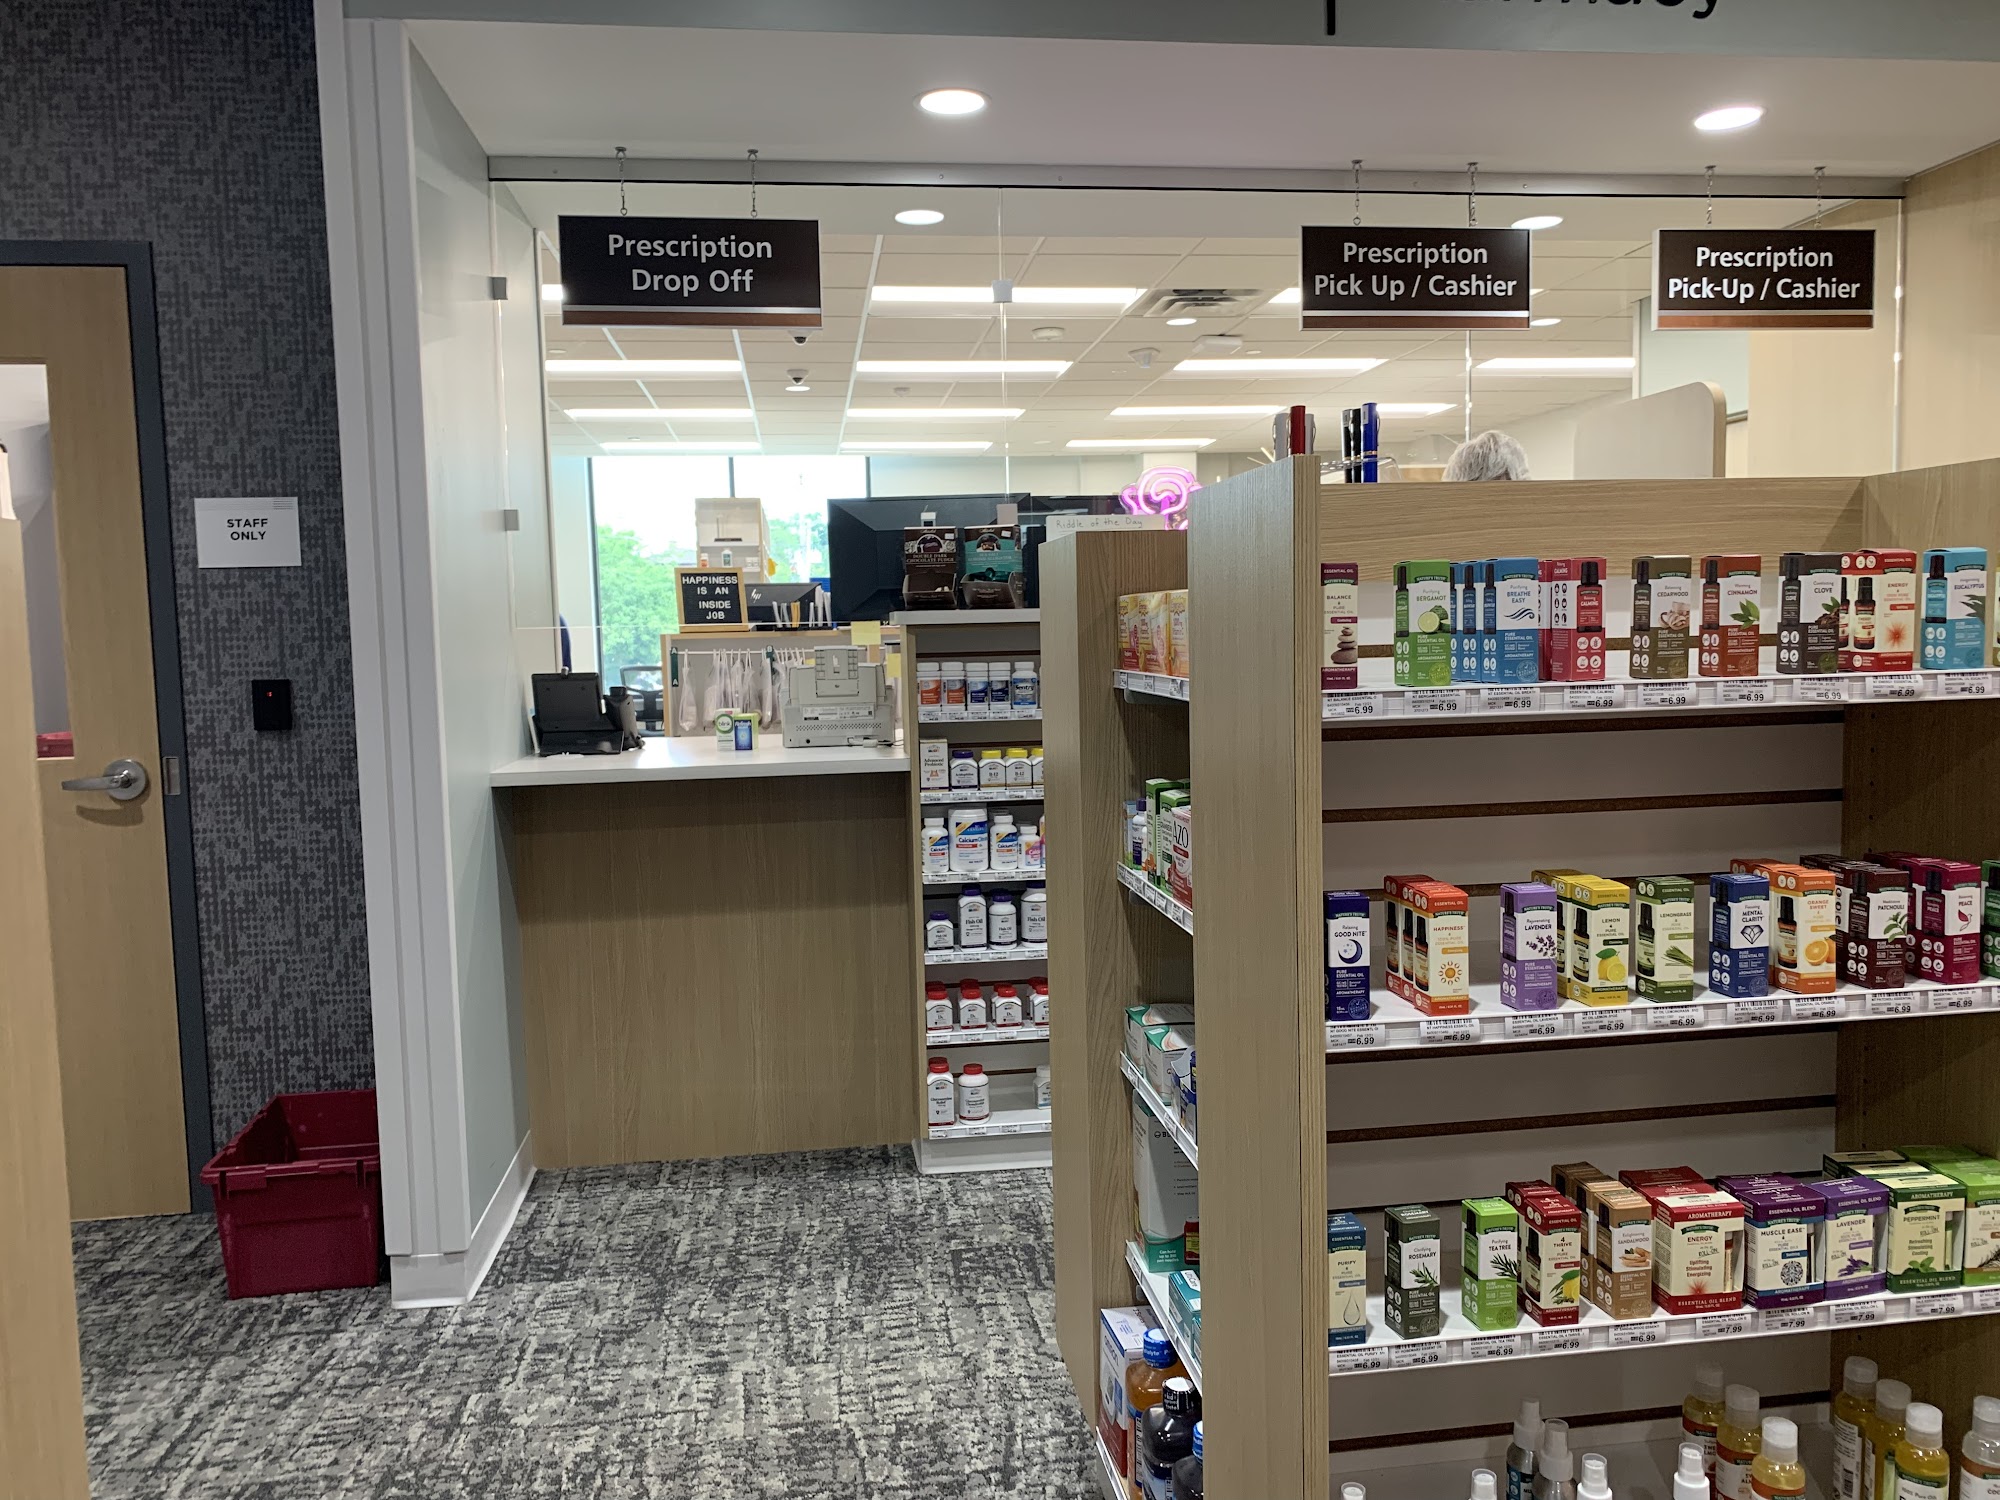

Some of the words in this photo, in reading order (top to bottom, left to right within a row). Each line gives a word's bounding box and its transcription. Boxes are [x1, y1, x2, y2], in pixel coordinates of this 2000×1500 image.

[608, 234, 773, 262] Prescription
[1343, 242, 1488, 268] Prescription
[1695, 246, 1834, 272] Prescription
[632, 269, 699, 296] Drop
[709, 269, 754, 292] Off
[1314, 274, 1363, 296] Pick
[1371, 275, 1404, 301] Up
[1411, 274, 1420, 297] /
[1428, 274, 1516, 297] Cashier
[1668, 278, 1754, 305] Pick-Up
[1759, 278, 1769, 301] /
[1776, 278, 1860, 300] Cashier
[227, 518, 268, 528] STAFF
[1056, 520, 1082, 528] Riddle
[1126, 518, 1142, 528] Day
[230, 531, 266, 540] ONLY
[683, 576, 737, 585] HAPPINESS
[699, 601, 731, 609] INSIDE
[706, 611, 725, 619] JOB
[1354, 706, 1373, 714] 6.99
[1438, 703, 1456, 711] 6.99
[1173, 821, 1188, 848] AZO
[1956, 1000, 1972, 1008] 6.99
[1819, 1010, 1835, 1018] 6.99
[1678, 1018, 1695, 1026] 6.99
[1537, 1027, 1555, 1035] 6.99
[1607, 1023, 1624, 1031] 6.99
[1356, 1037, 1374, 1045] 6.99
[1911, 1191, 1953, 1199] AROMATHERAPY
[1688, 1211, 1732, 1220] AROMATHERAPY
[1903, 1215, 1940, 1223] PEPPERMINT
[1836, 1219, 1866, 1228] LAVENDER
[1421, 1355, 1438, 1363] 6.99
